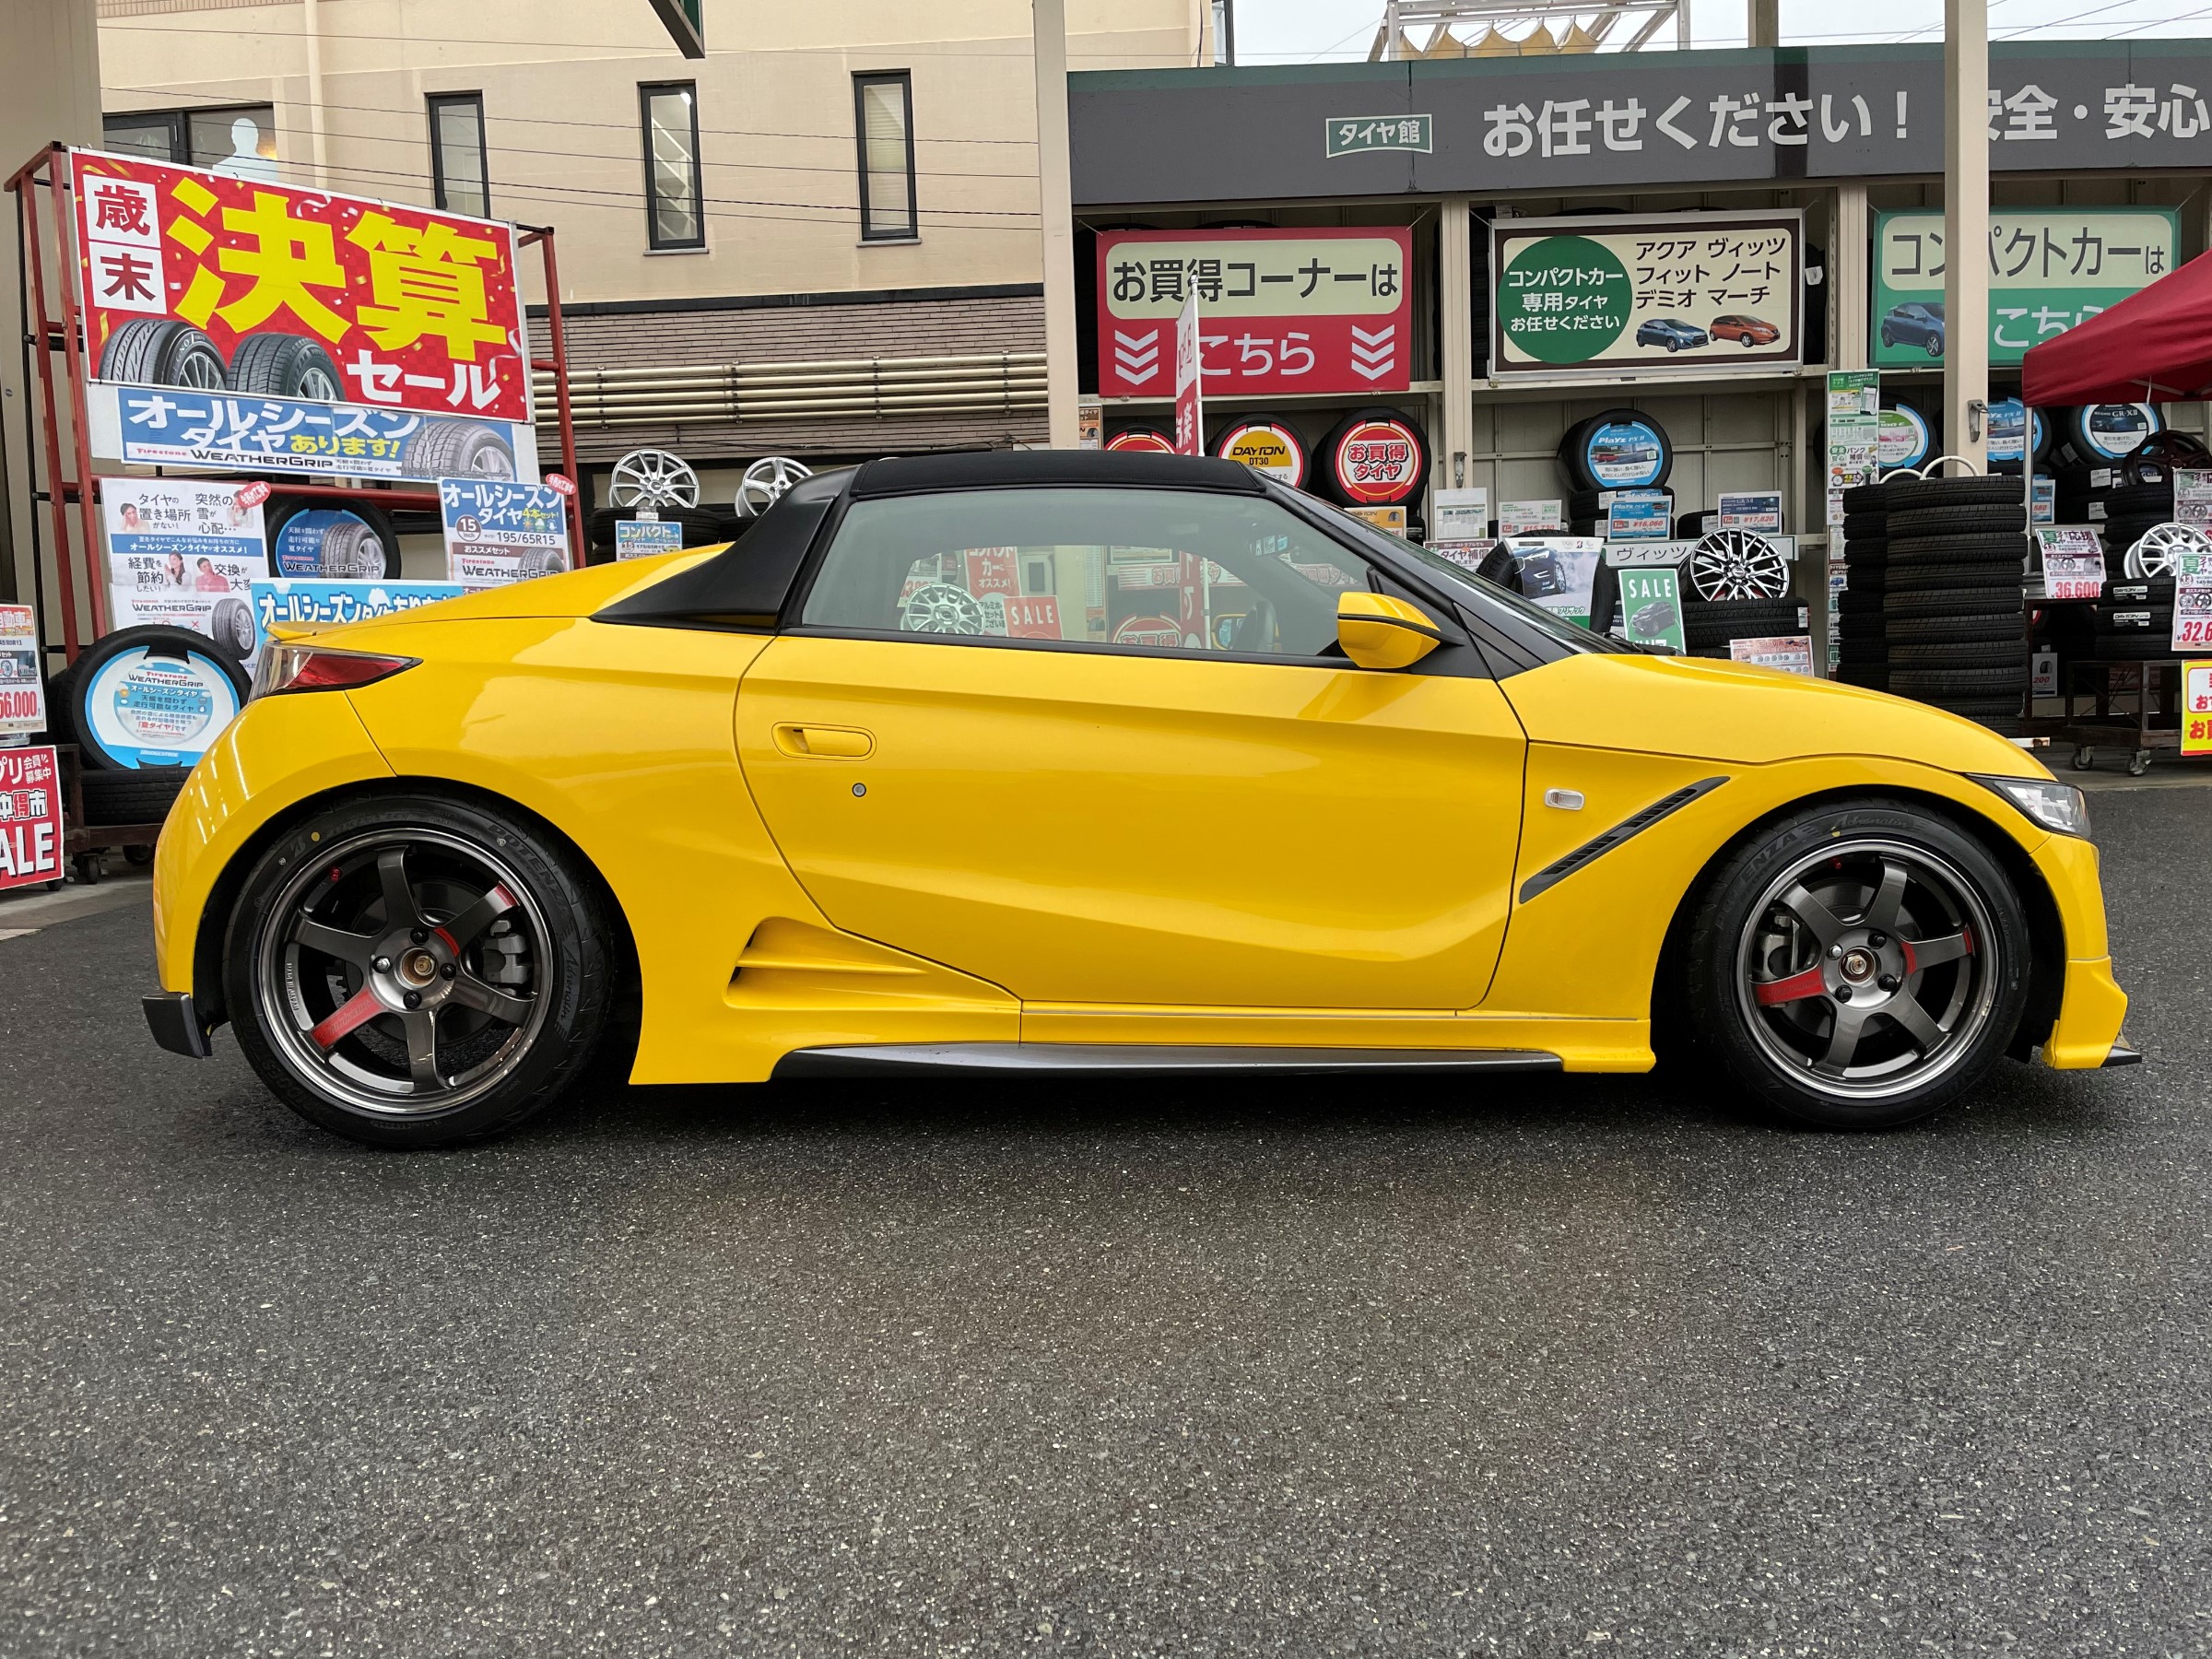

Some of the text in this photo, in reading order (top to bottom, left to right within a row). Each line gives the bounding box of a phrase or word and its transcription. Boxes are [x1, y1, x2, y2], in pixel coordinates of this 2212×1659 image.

[1988, 84, 2211, 141] 全・安心
[1337, 119, 1421, 148] タイヤ館
[94, 184, 157, 301] 歳末
[1636, 235, 1786, 261] アクア ヴィッツ
[166, 177, 507, 361] 決算
[1508, 266, 1624, 288] コンパクトカー
[1636, 261, 1781, 285] フィット ノート
[1112, 258, 1398, 303] お買得コーナーは
[1522, 292, 1608, 312] 専用タイヤ
[1635, 287, 1771, 312] デミオ マーチ
[1510, 315, 1620, 333] お任せください
[347, 349, 501, 410] セール
[127, 395, 421, 440] オールシーズン
[136, 448, 188, 457] Firestone
[1232, 446, 1286, 455] DAYTON
[1348, 442, 1407, 462] お買得
[1249, 457, 1269, 465] DT30
[1355, 463, 1401, 480] タイヤ
[139, 494, 180, 506] タイヤの
[195, 493, 233, 506] 突然の
[441, 483, 560, 509] オールシーズン
[139, 509, 192, 522] 置き場所
[197, 508, 216, 521] 雪が
[460, 519, 477, 532] 15
[497, 532, 556, 546] 195/65R15
[465, 545, 511, 555] おススメセット
[1617, 547, 1688, 561] ヴィッツ
[128, 558, 162, 571] 経費を
[214, 563, 248, 576] 交換が
[2182, 556, 2200, 574] 夏
[137, 571, 164, 585] 節約
[1152, 567, 1180, 585] お買
[1629, 578, 1672, 598] SALE
[2055, 582, 2100, 598] 36,600
[1010, 605, 1054, 626] SALE
[131, 685, 198, 697] オールシーズンタイヤ
[24, 755, 41, 771] 会員
[26, 767, 52, 784] 募集中
